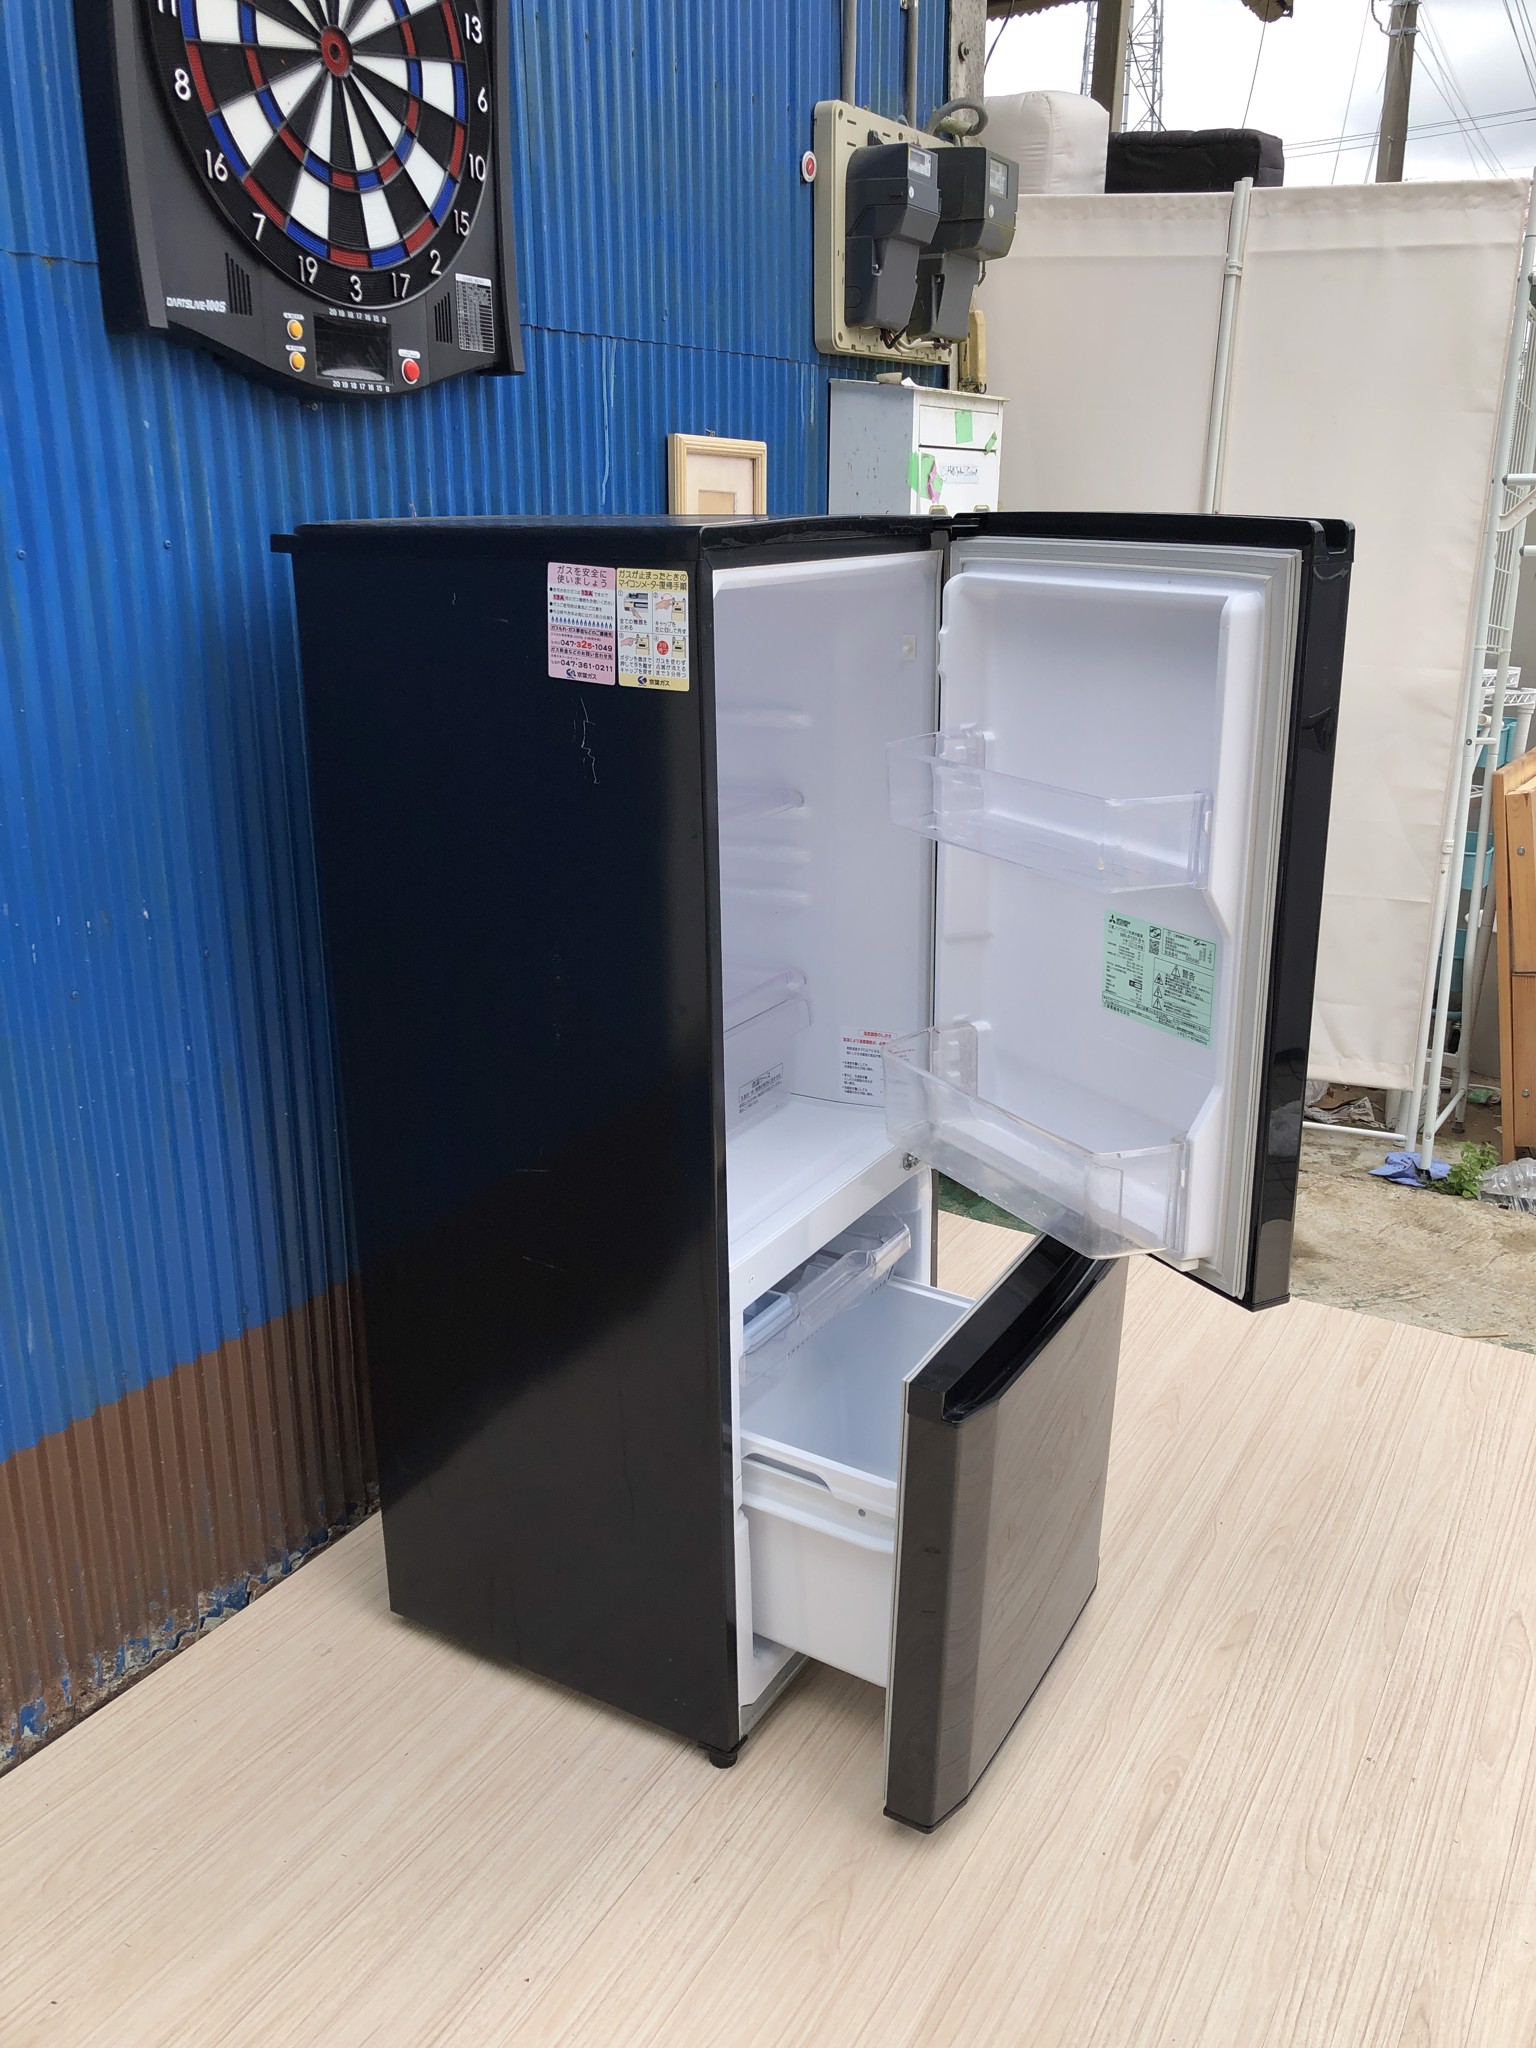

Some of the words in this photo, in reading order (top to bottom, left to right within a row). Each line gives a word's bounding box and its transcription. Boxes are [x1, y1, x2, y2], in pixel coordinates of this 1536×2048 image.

[465, 13, 482, 44] 13
[175, 68, 191, 101] 8
[477, 86, 488, 113] 6
[205, 149, 228, 182] 16
[469, 153, 486, 181] 10
[253, 212, 266, 241] 7
[454, 209, 469, 236] 15
[299, 255, 318, 284] 19
[430, 250, 442, 276] 2
[350, 275, 362, 302] 3
[391, 272, 410, 298] 17
[557, 565, 607, 579] ガスを安全に
[557, 575, 607, 588] 使いましょう
[618, 570, 687, 581] ガスが止まったときの
